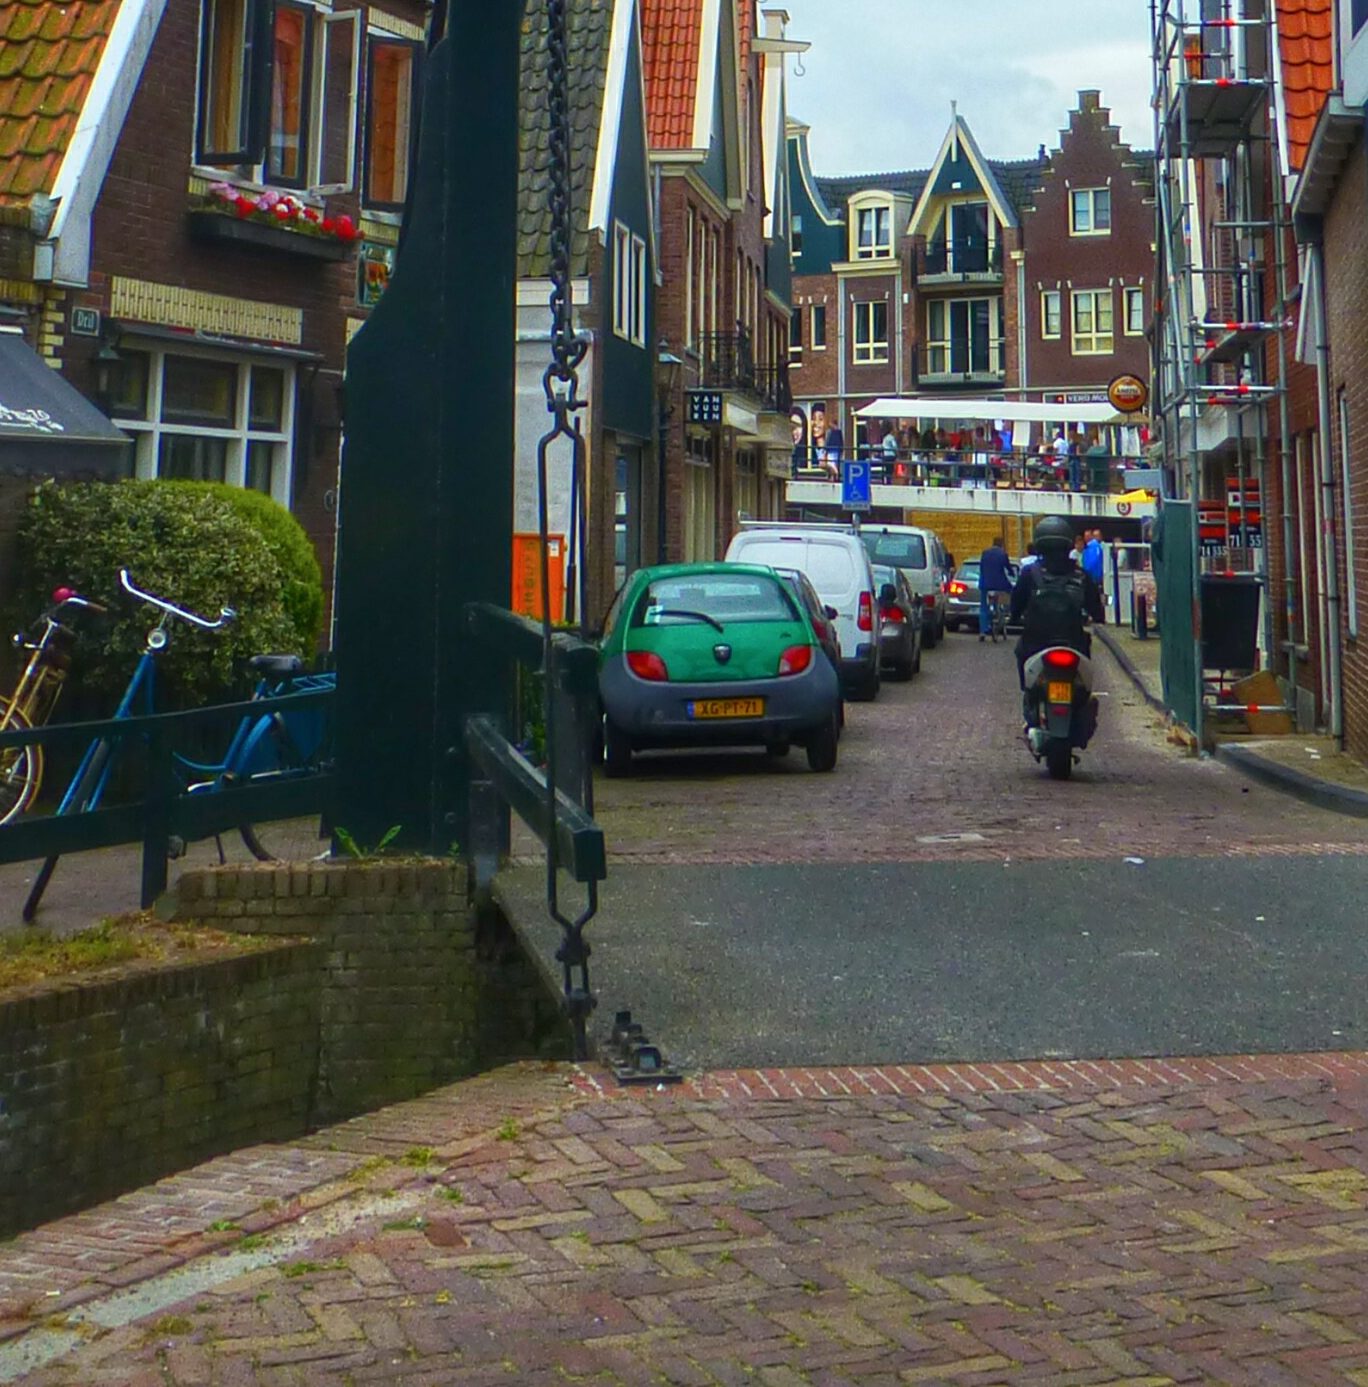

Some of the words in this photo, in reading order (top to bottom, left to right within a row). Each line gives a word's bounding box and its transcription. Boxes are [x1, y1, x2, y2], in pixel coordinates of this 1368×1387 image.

[77, 310, 95, 329] Dril
[849, 464, 864, 485] P
[701, 700, 758, 716] XG-PT-71
